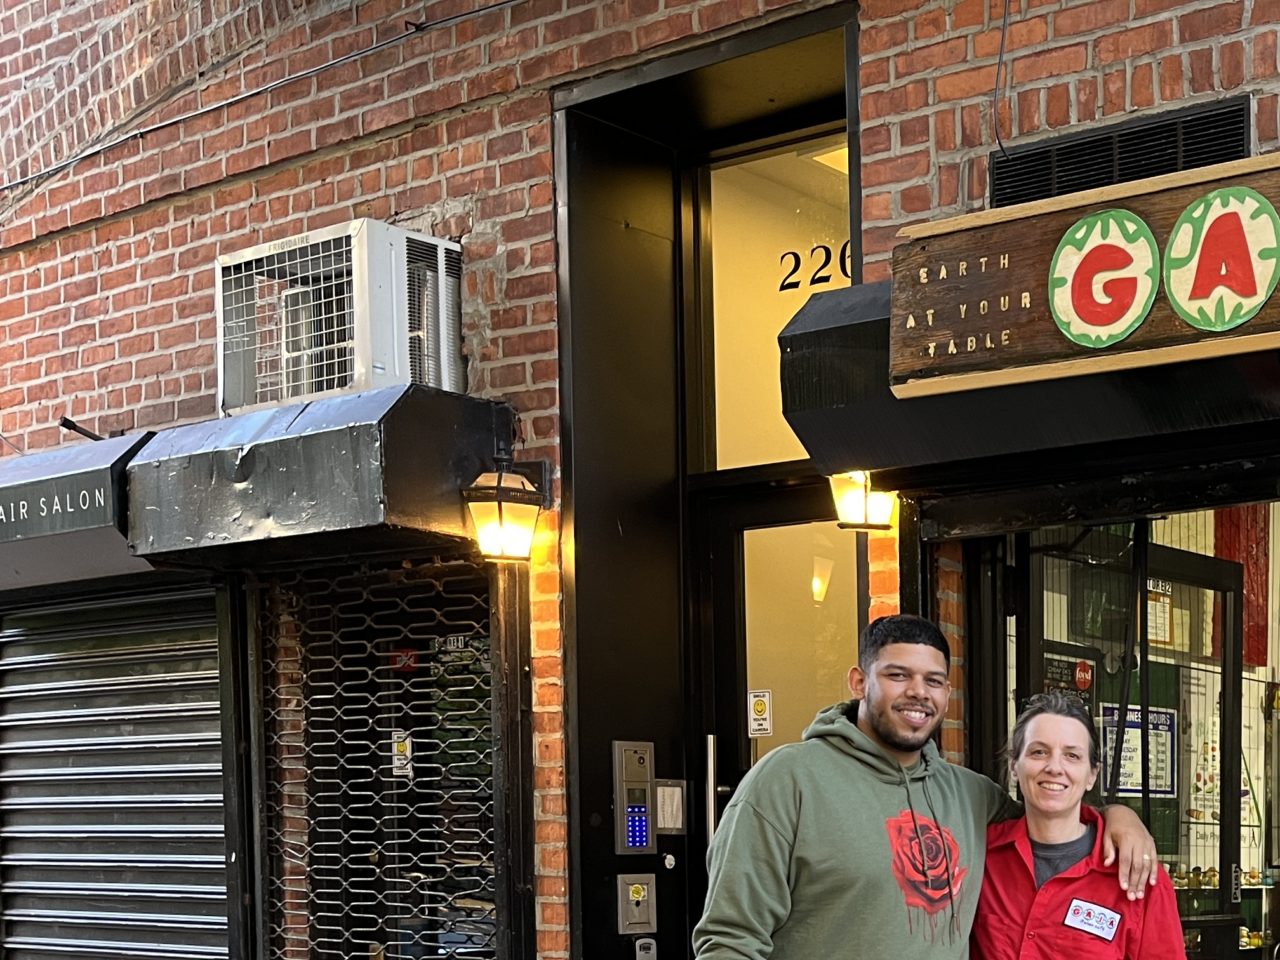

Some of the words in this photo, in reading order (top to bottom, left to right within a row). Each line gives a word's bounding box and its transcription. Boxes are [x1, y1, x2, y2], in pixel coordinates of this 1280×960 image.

[918, 253, 1010, 284] EARTH
[906, 309, 935, 329] AT
[959, 292, 1031, 319] YOUR
[928, 330, 1011, 358] TABLE
[40, 487, 104, 517] SALON
